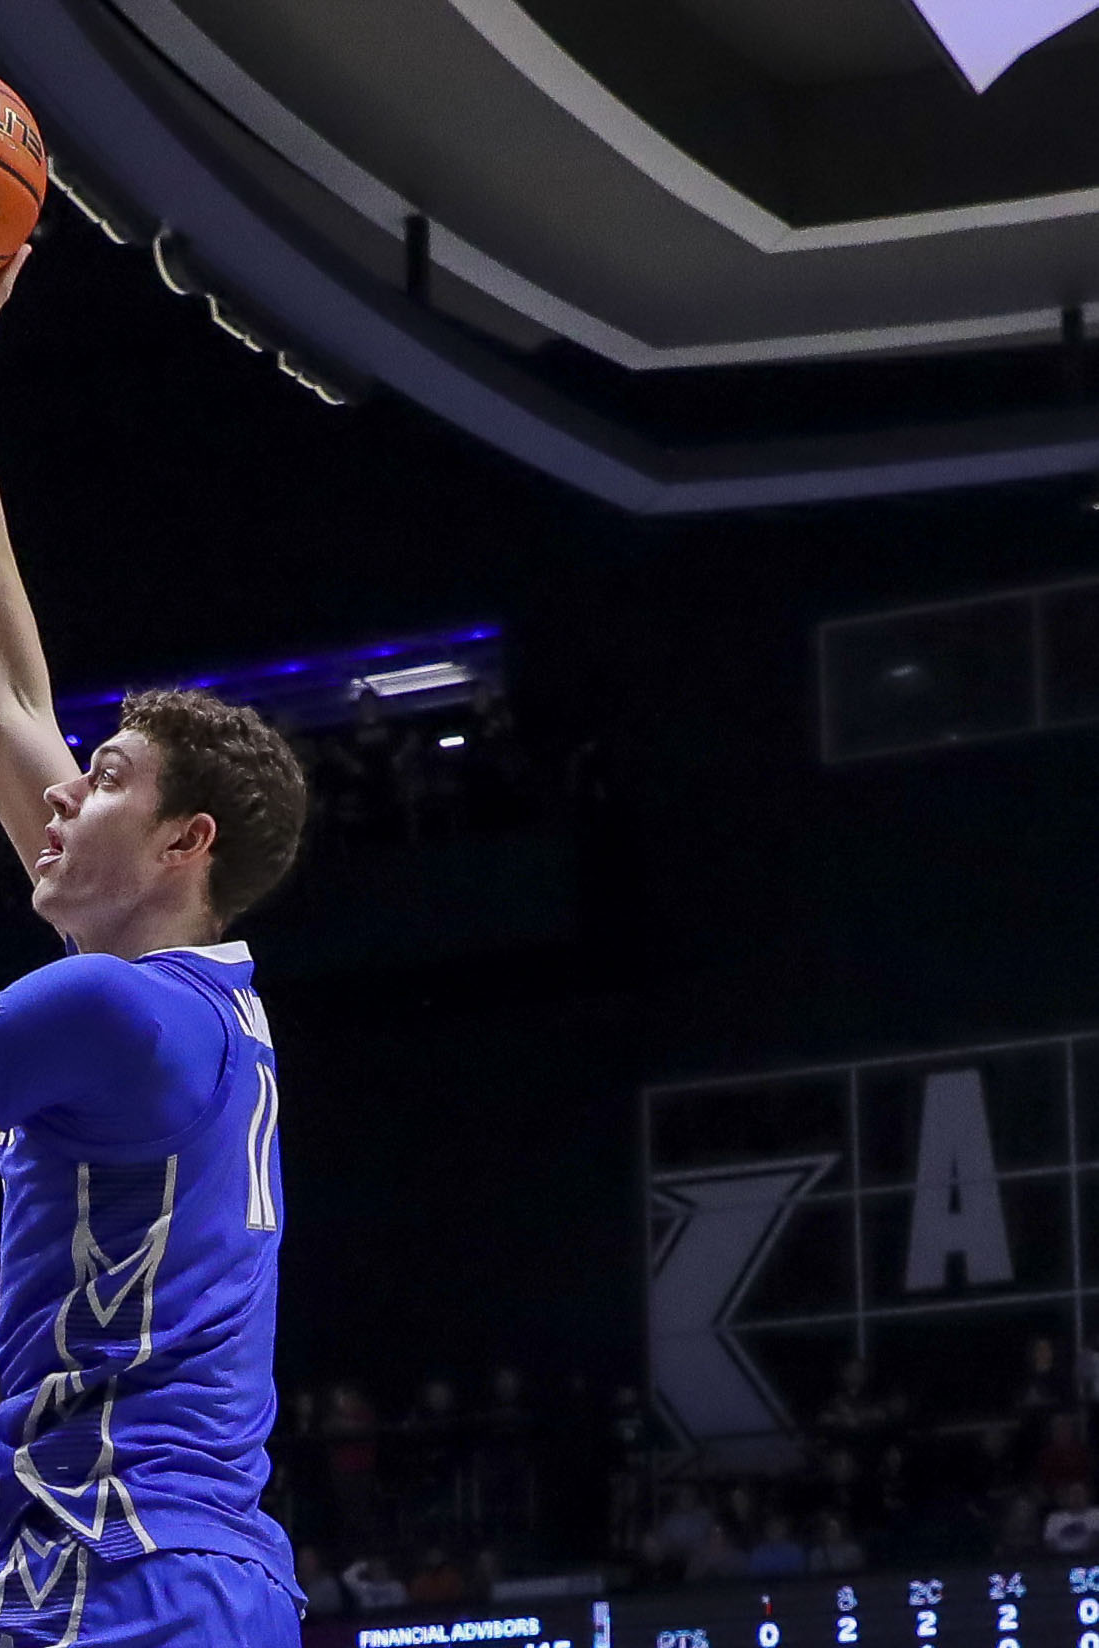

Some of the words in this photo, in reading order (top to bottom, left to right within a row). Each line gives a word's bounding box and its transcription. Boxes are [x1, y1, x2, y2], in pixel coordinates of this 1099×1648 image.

[246, 1061, 278, 1231] 11
[989, 1572, 1027, 1600] 24
[359, 1624, 450, 1648] FINANCIAL
[451, 1617, 540, 1640] ADVISORS
[759, 1622, 780, 1648] 0
[837, 1616, 858, 1643] 2
[917, 1610, 937, 1637] 2
[997, 1604, 1019, 1631] 2
[1078, 1598, 1099, 1626] 0
